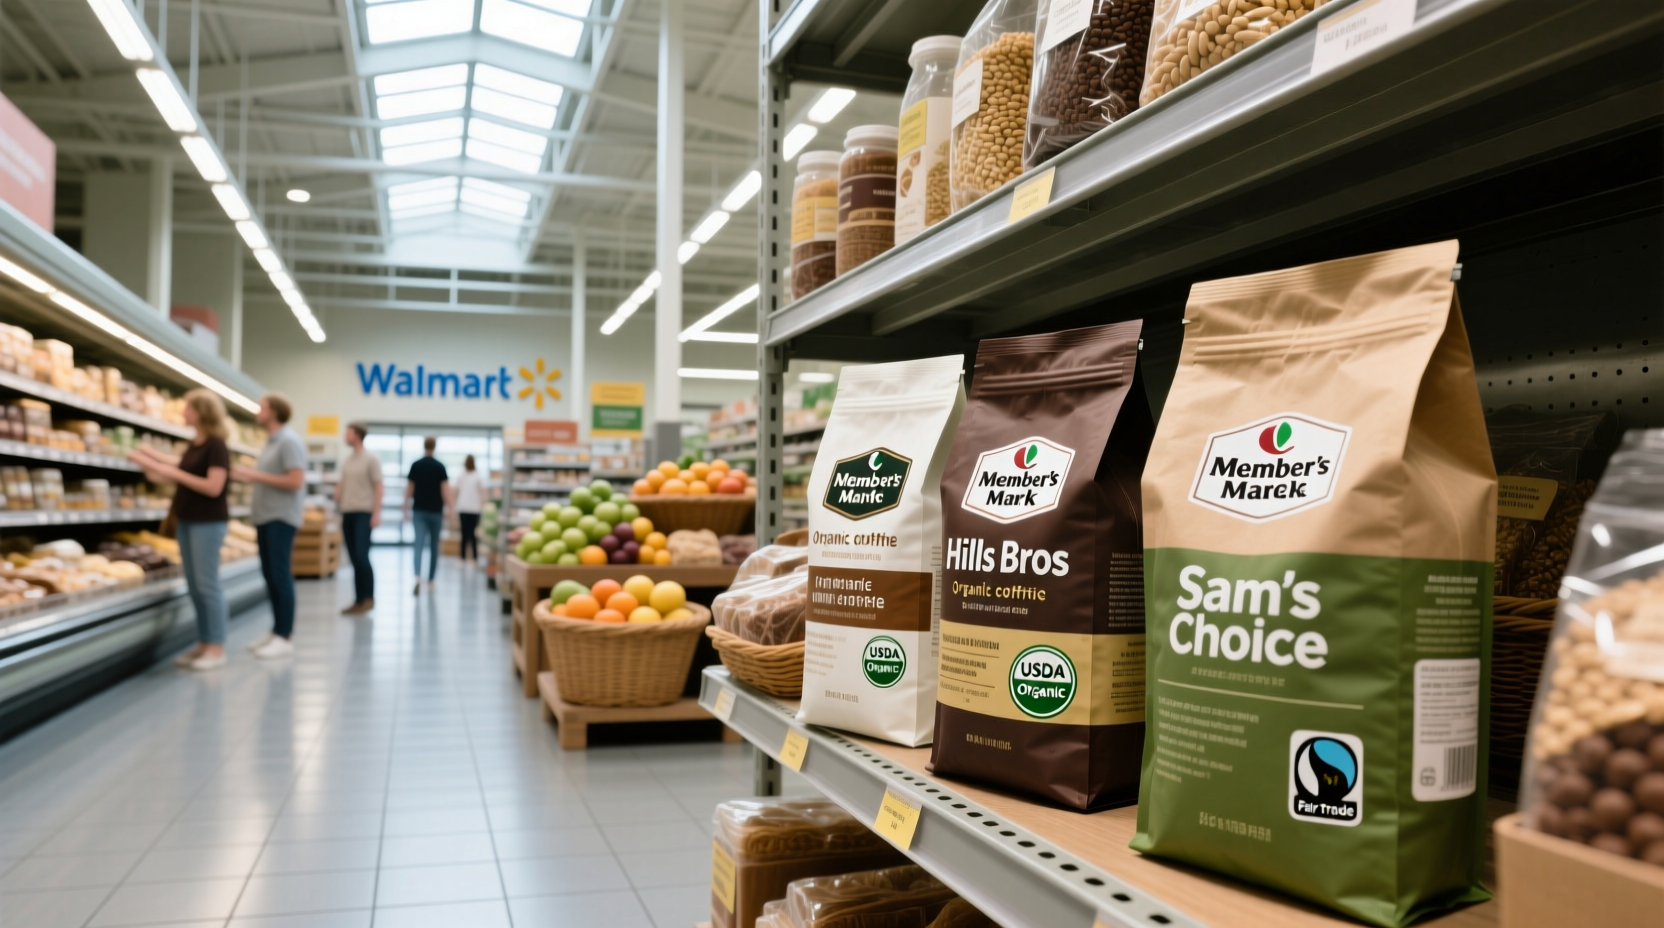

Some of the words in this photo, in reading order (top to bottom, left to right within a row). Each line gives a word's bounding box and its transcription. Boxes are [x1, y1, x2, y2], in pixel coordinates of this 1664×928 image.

[356, 362, 512, 400] Walmart
[1209, 455, 1331, 479] Member's
[833, 471, 902, 488] Member's
[978, 470, 1060, 488] Member's
[986, 489, 1039, 507] Mark
[946, 537, 995, 573] Hills
[1000, 540, 1070, 577] Bros
[1176, 564, 1321, 620] Sam's
[1169, 611, 1329, 670] Choice
[869, 646, 900, 659] USDA
[1021, 661, 1065, 679] USDA
[1017, 683, 1066, 699] Organic
[1298, 799, 1319, 814] Fair
[1319, 803, 1355, 817] Trade
